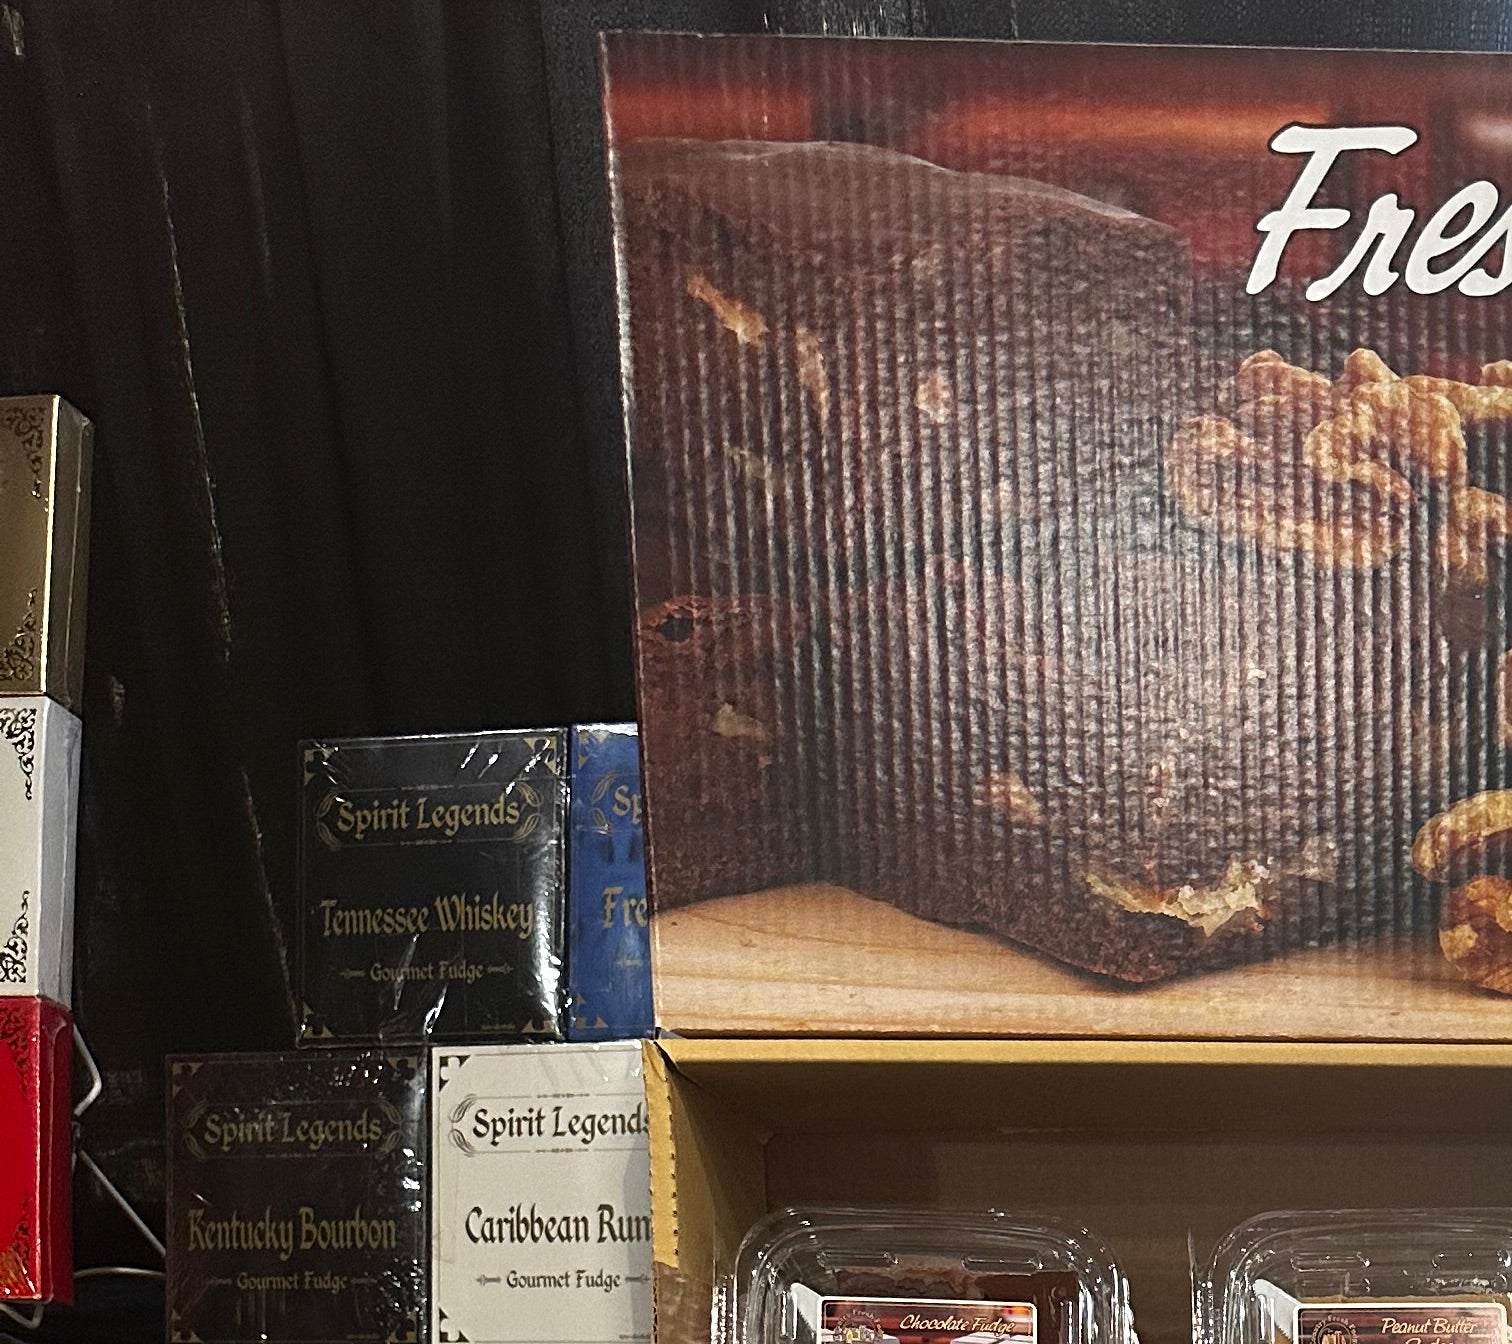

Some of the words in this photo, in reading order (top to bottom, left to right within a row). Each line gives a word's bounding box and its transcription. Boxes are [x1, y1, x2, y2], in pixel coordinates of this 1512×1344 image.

[337, 800, 410, 840] Spirit
[416, 795, 520, 837] Legends
[321, 898, 430, 938] Tennessee
[431, 890, 536, 940] Whiskey
[370, 962, 434, 982] Gourmet
[438, 960, 484, 985] Fudge
[204, 1110, 277, 1152] Spirit
[281, 1107, 383, 1150] Legends
[472, 1107, 546, 1147] Spirit
[187, 1205, 294, 1262] Kentucky
[299, 1204, 398, 1250] Bourbon
[464, 1202, 590, 1245] Caribbean
[236, 1270, 299, 1291] Gourmet
[303, 1270, 349, 1295] Fudge
[506, 1269, 571, 1290] Gourmet
[575, 1268, 622, 1293] Fudge
[899, 1313, 970, 1332] Chocolate
[971, 1317, 1016, 1338] Fudge
[1381, 1316, 1432, 1335] Peanut
[1432, 1317, 1479, 1336] Butter
